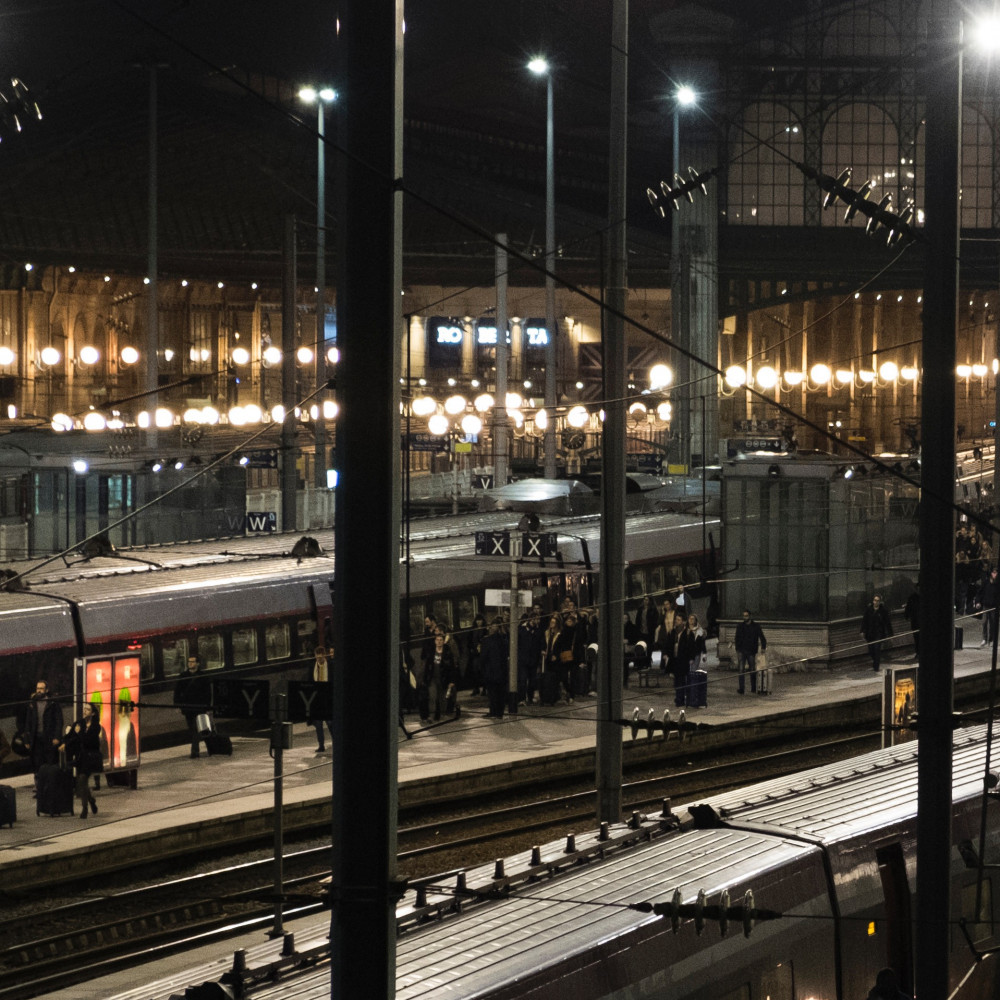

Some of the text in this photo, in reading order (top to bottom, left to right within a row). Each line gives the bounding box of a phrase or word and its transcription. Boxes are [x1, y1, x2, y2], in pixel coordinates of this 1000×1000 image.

[527, 327, 549, 344] TA
[481, 478, 490, 489] V
[227, 516, 244, 530] W
[249, 516, 267, 531] W
[491, 537, 505, 555] X
[527, 538, 541, 556] X
[242, 689, 260, 716] Y
[298, 690, 318, 717] Y
